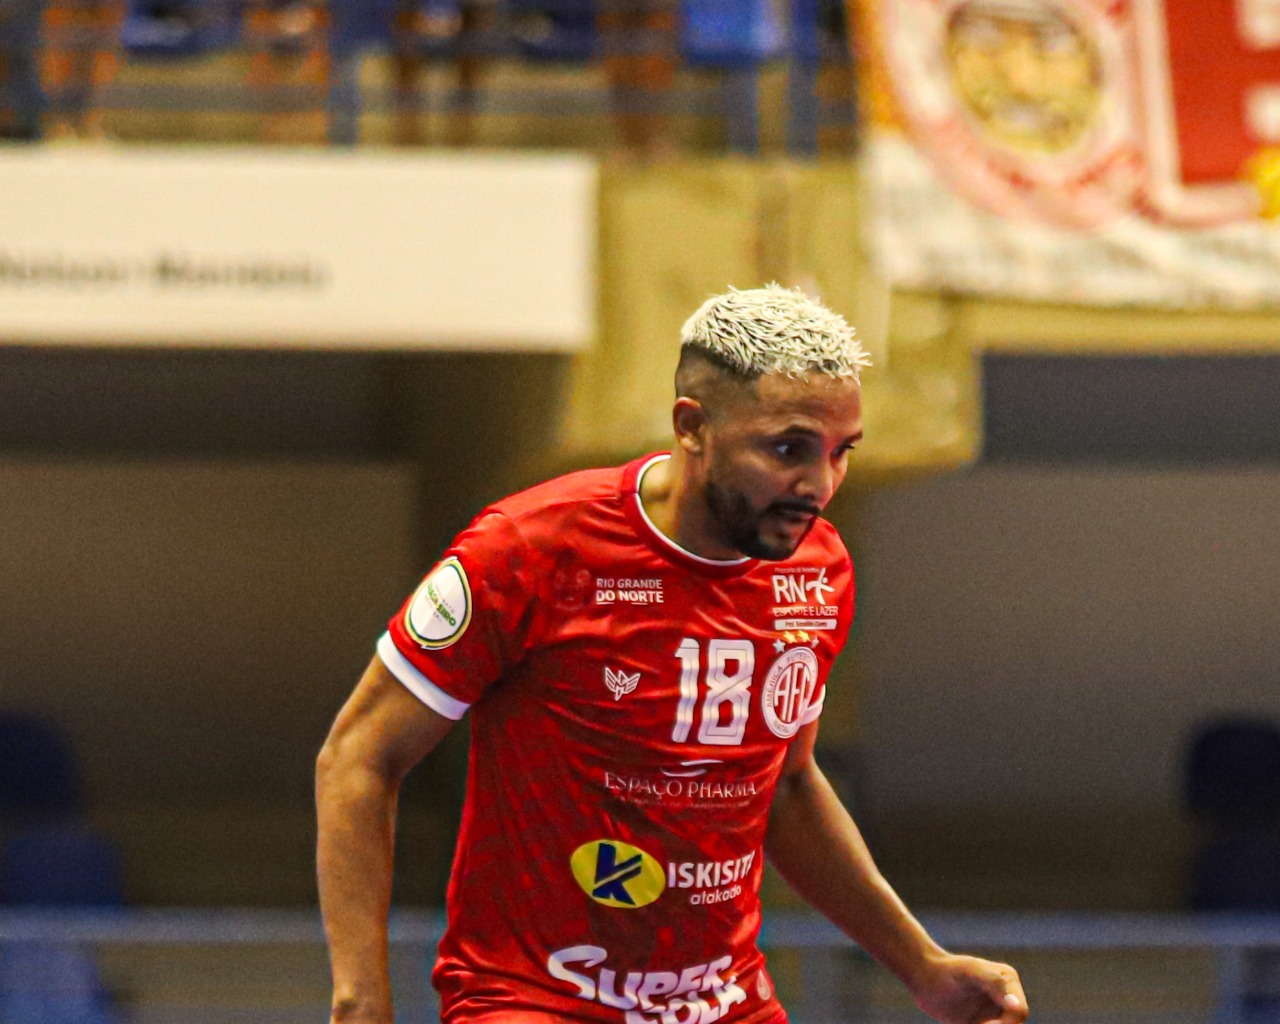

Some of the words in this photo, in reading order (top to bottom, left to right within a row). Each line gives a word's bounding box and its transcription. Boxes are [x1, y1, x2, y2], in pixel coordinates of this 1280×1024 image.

[596, 578, 615, 588] RIO
[617, 579, 663, 589] GRANDE
[596, 590, 616, 602] DO
[618, 590, 664, 603] NORTE
[772, 574, 808, 603] RN
[816, 606, 839, 616] LAZER
[672, 637, 756, 746] 18
[773, 662, 812, 723] AFC
[605, 771, 683, 799] ESPAÇO
[688, 781, 757, 798] PHARMA
[690, 884, 742, 905] atakado
[547, 944, 733, 1011] SUPER
